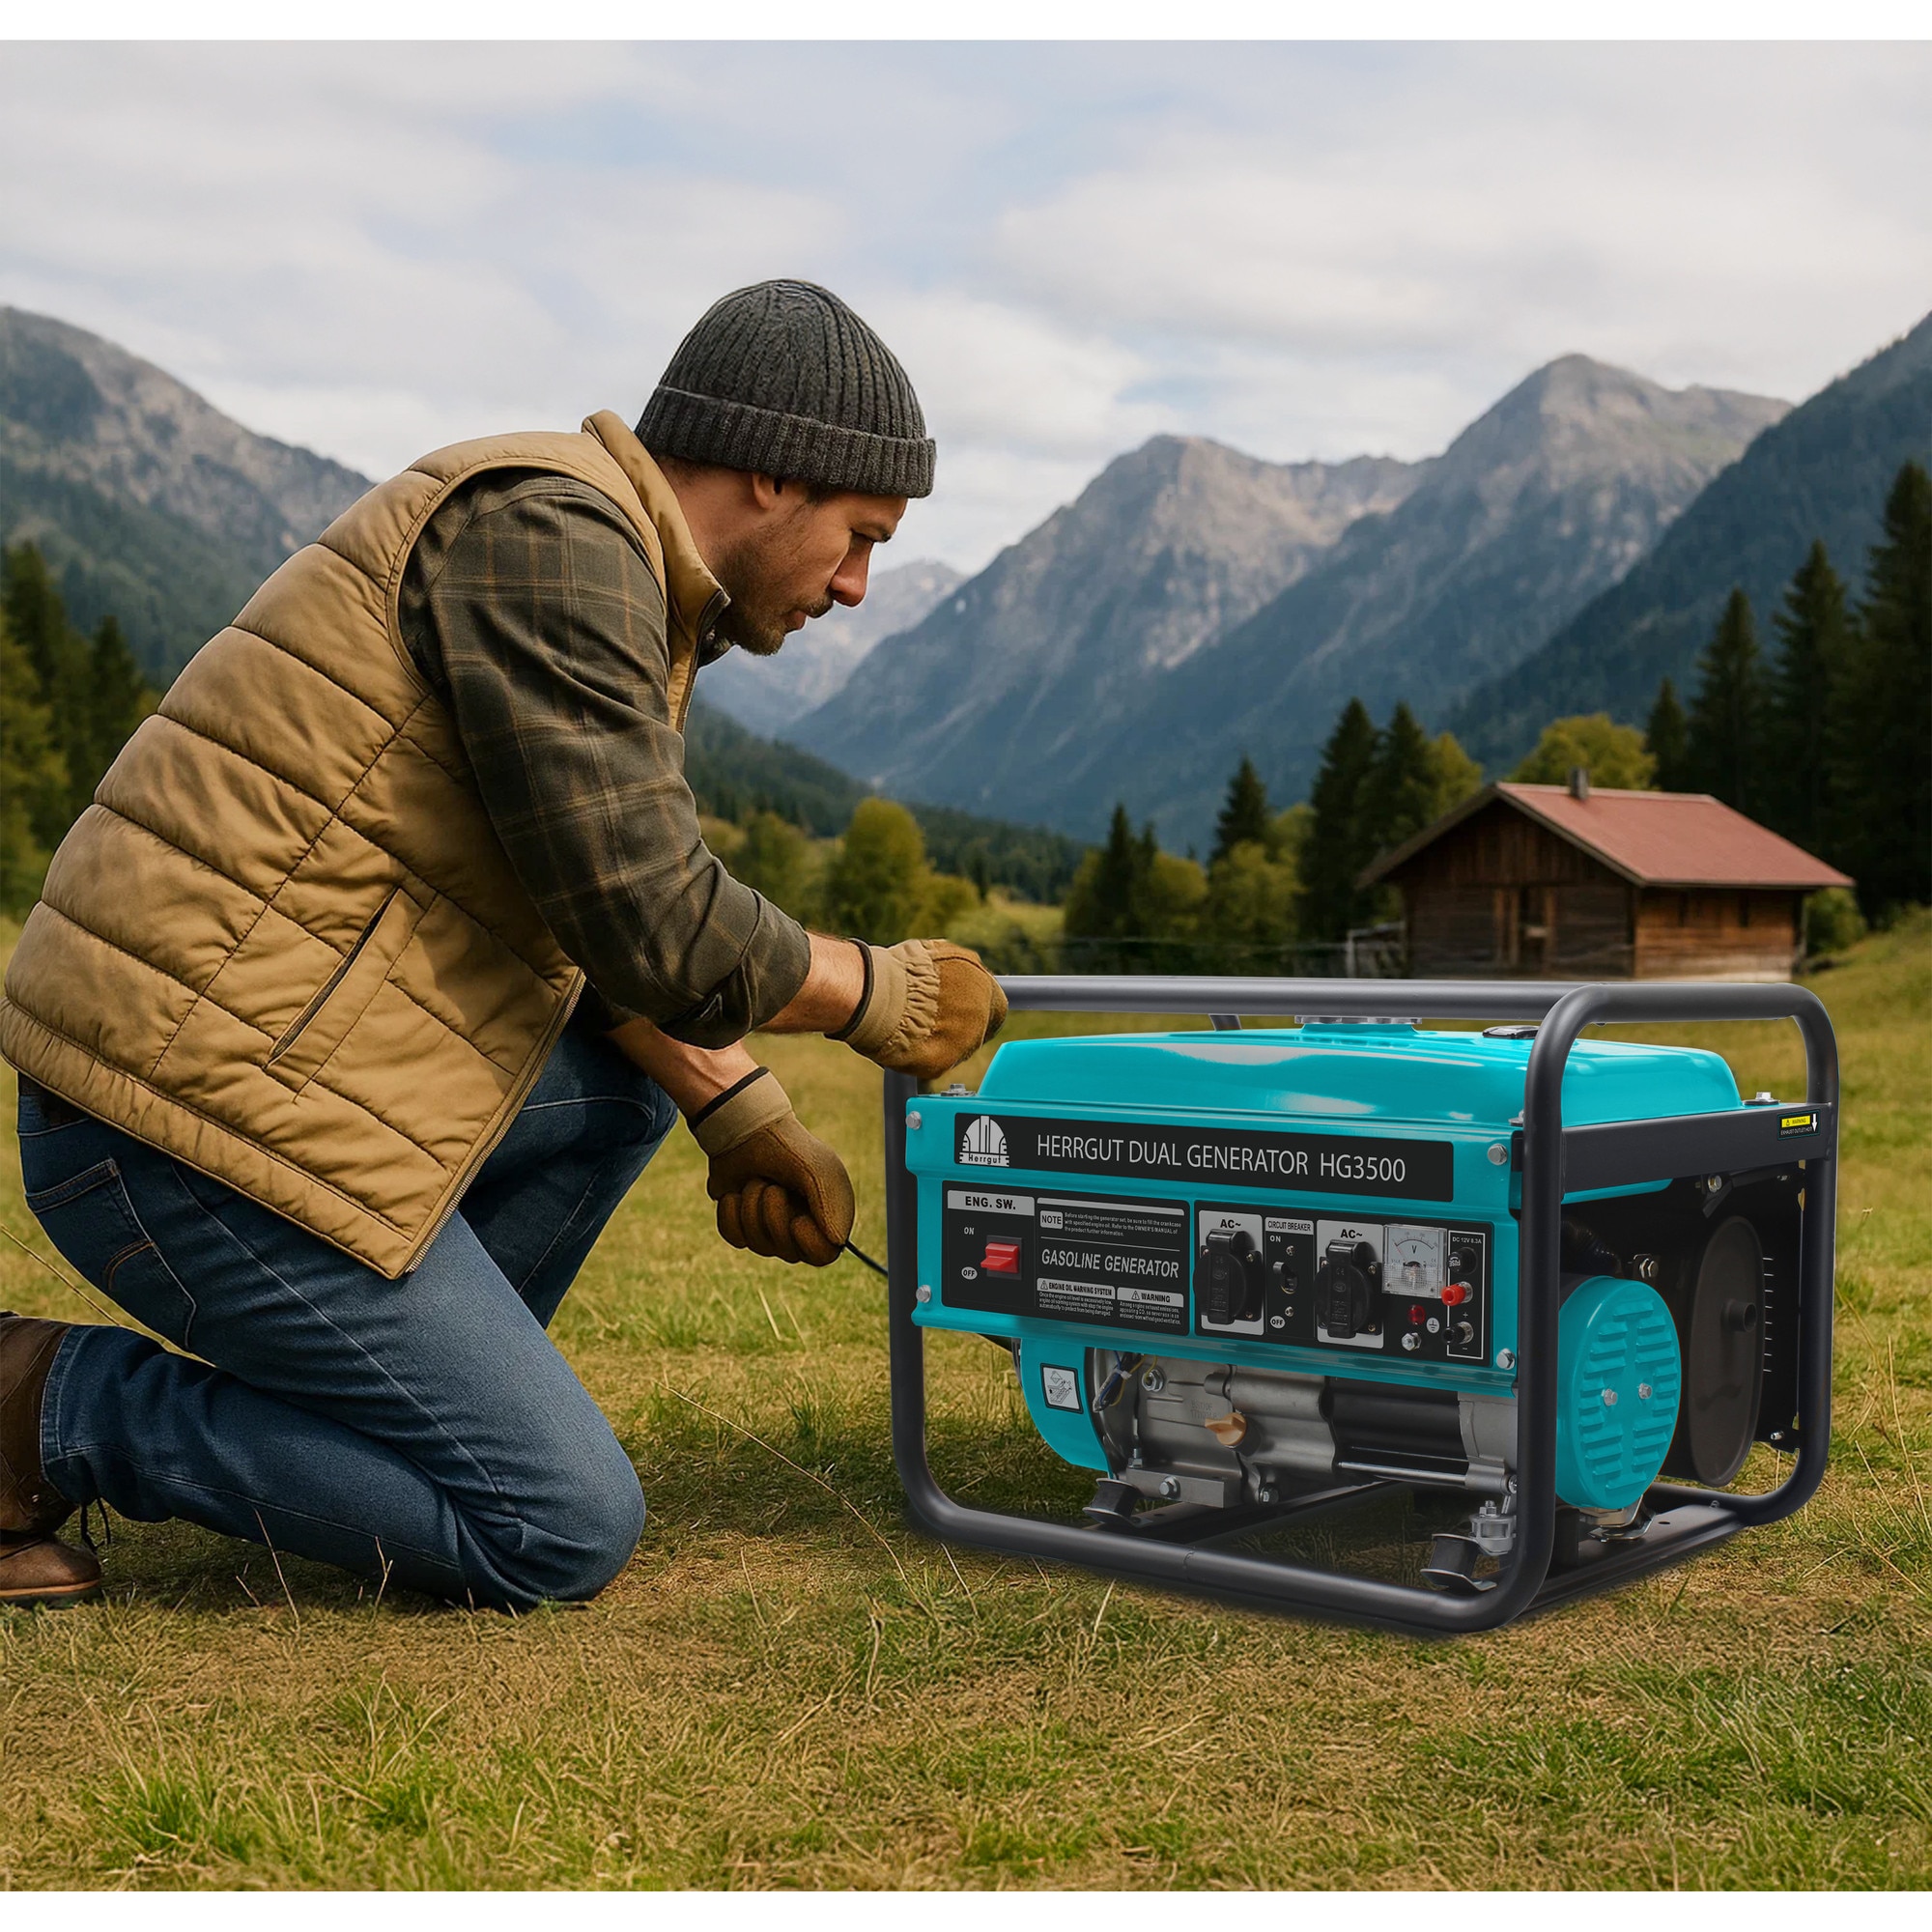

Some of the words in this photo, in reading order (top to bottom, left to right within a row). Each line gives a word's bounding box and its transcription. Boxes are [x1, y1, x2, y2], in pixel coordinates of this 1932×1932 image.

[968, 1153, 1001, 1165] Herrgut
[1037, 1134, 1123, 1162] HERRGUT
[1129, 1140, 1181, 1166] DUAL
[1186, 1145, 1308, 1176] GENERATOR
[1320, 1152, 1406, 1182] HG3500
[965, 1196, 992, 1208] ENG.
[995, 1199, 1016, 1210] SW.
[1041, 1214, 1062, 1225] NOTE
[1268, 1220, 1287, 1229] CIRCUIT
[1288, 1222, 1311, 1232] BREAKER
[1411, 1245, 1417, 1254] V
[1041, 1249, 1100, 1269] GASOLINE
[1105, 1255, 1179, 1278] GENERATOR
[1049, 1282, 1065, 1291] ENGINE
[1073, 1285, 1094, 1294] WARNING
[1094, 1287, 1112, 1295] SYSTEM
[1141, 1293, 1171, 1303] WARNING
